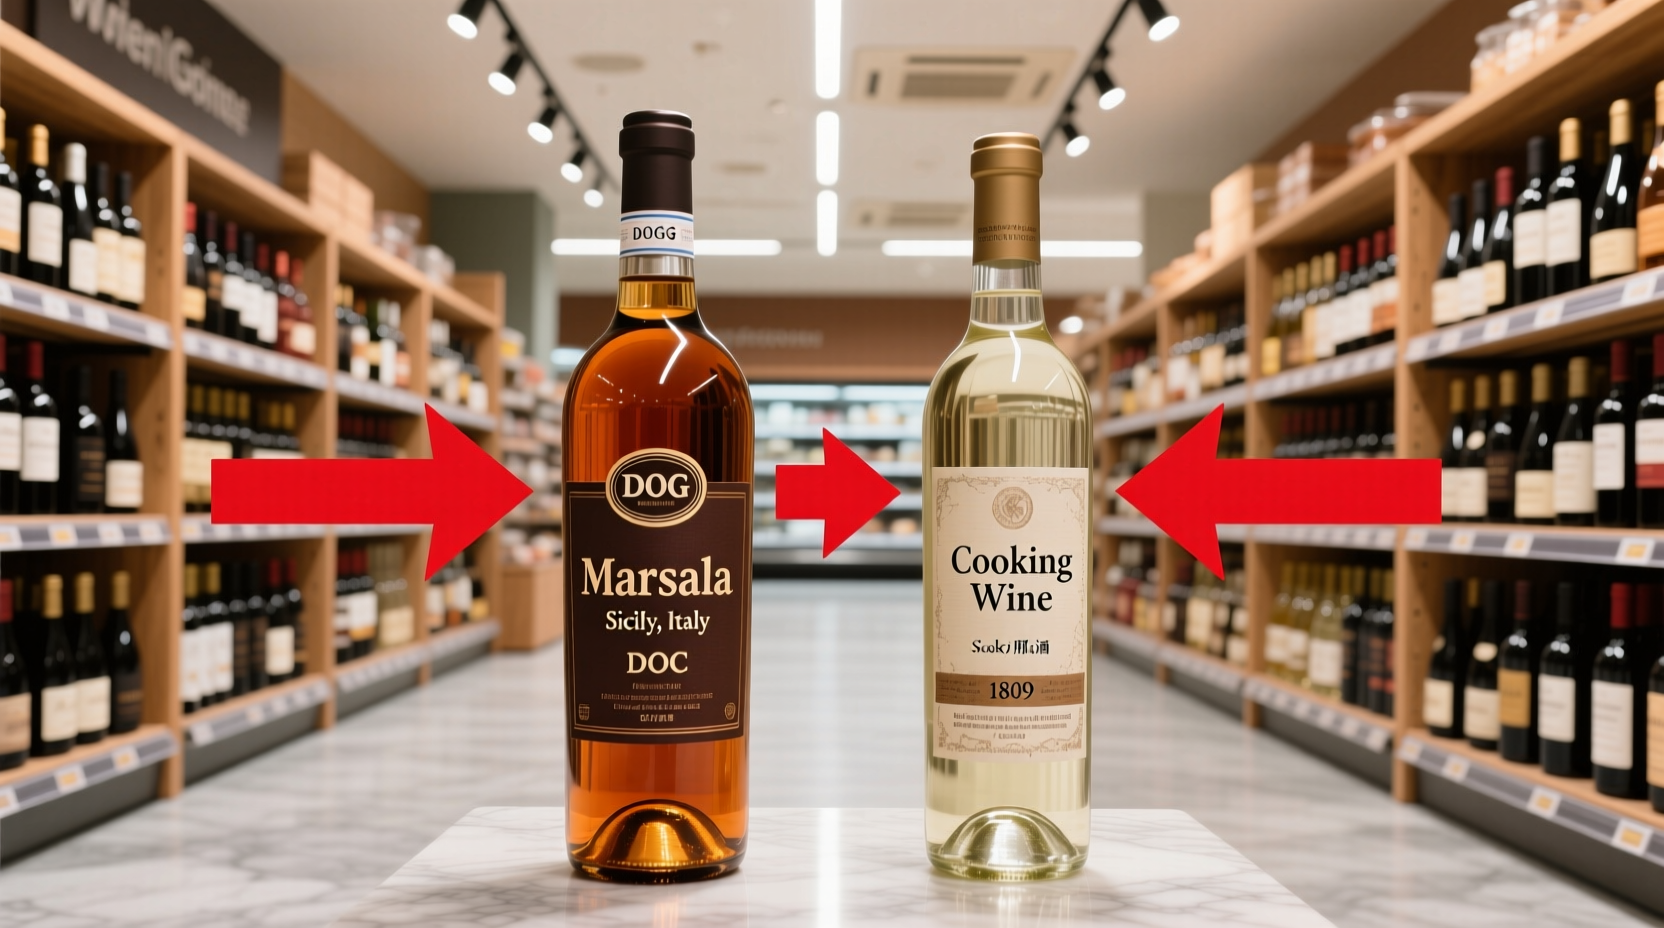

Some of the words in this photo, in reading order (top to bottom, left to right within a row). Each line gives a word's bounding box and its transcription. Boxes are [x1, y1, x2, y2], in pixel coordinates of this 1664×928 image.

[633, 226, 676, 240] DOGG
[622, 474, 690, 498] DOG
[951, 545, 1073, 583] Cooking
[581, 556, 733, 597] Marsala
[970, 584, 1053, 612] Wine
[605, 611, 662, 635] Sicily,
[668, 611, 711, 635] Italy
[626, 652, 688, 674] DOC
[990, 682, 1034, 700] 1809
